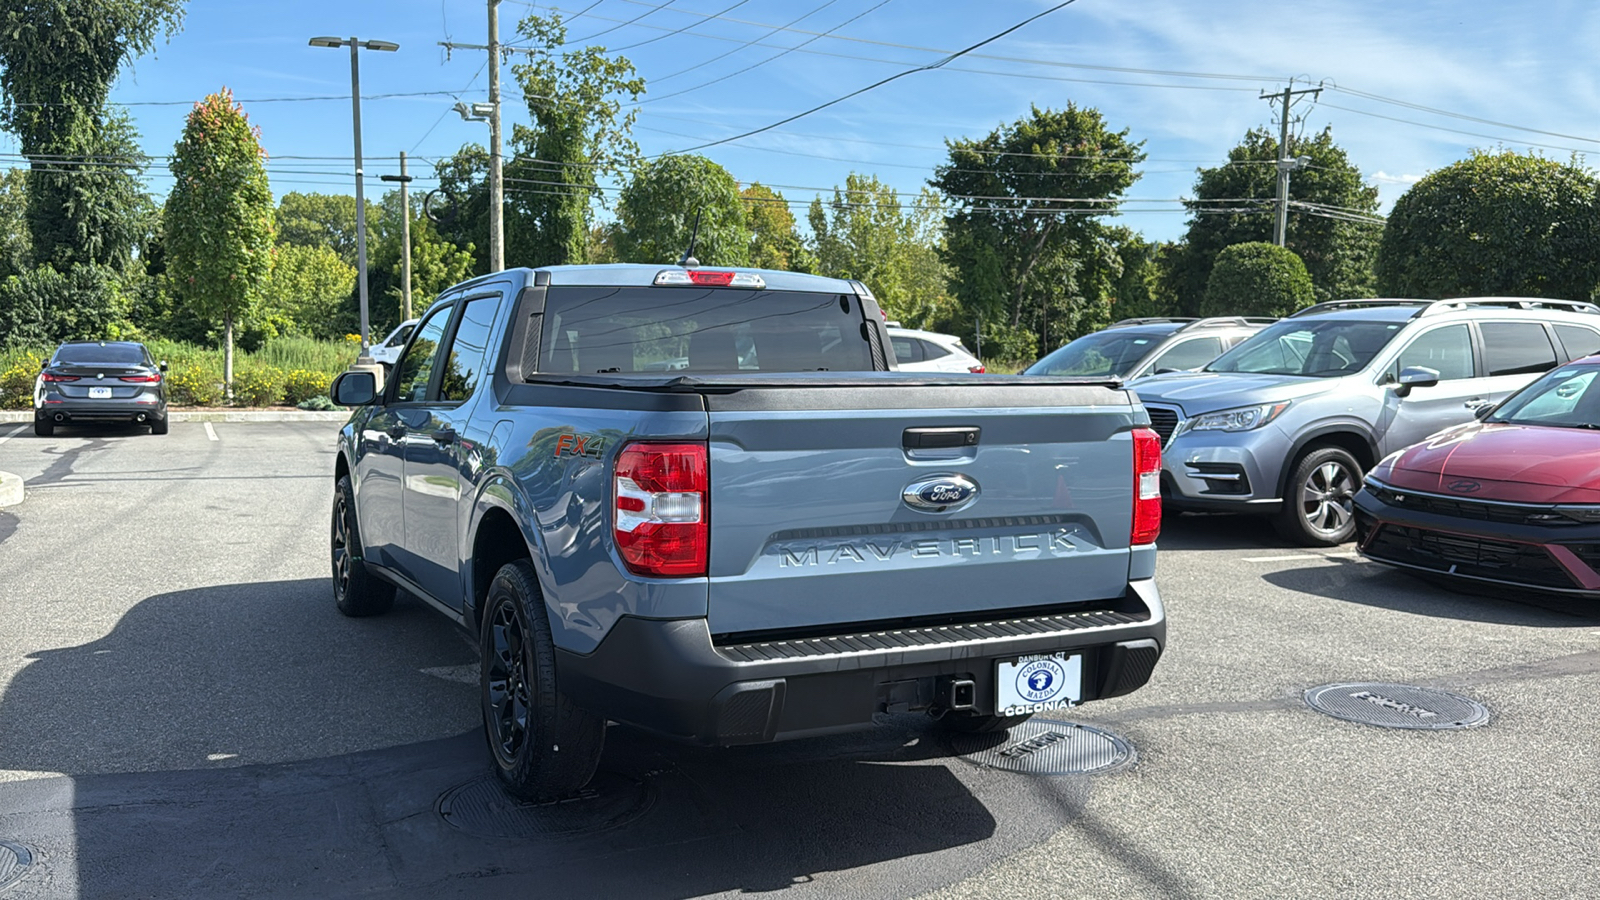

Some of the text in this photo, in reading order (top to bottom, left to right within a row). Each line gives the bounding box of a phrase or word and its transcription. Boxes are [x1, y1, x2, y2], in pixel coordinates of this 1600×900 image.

[554, 434, 606, 460] FX4
[930, 485, 962, 501] Ford
[778, 528, 1080, 567] MAVERICK
[1022, 661, 1059, 678] COLONIAL
[1026, 687, 1055, 699] MAZDA
[1005, 700, 1076, 717] COLONIAL
